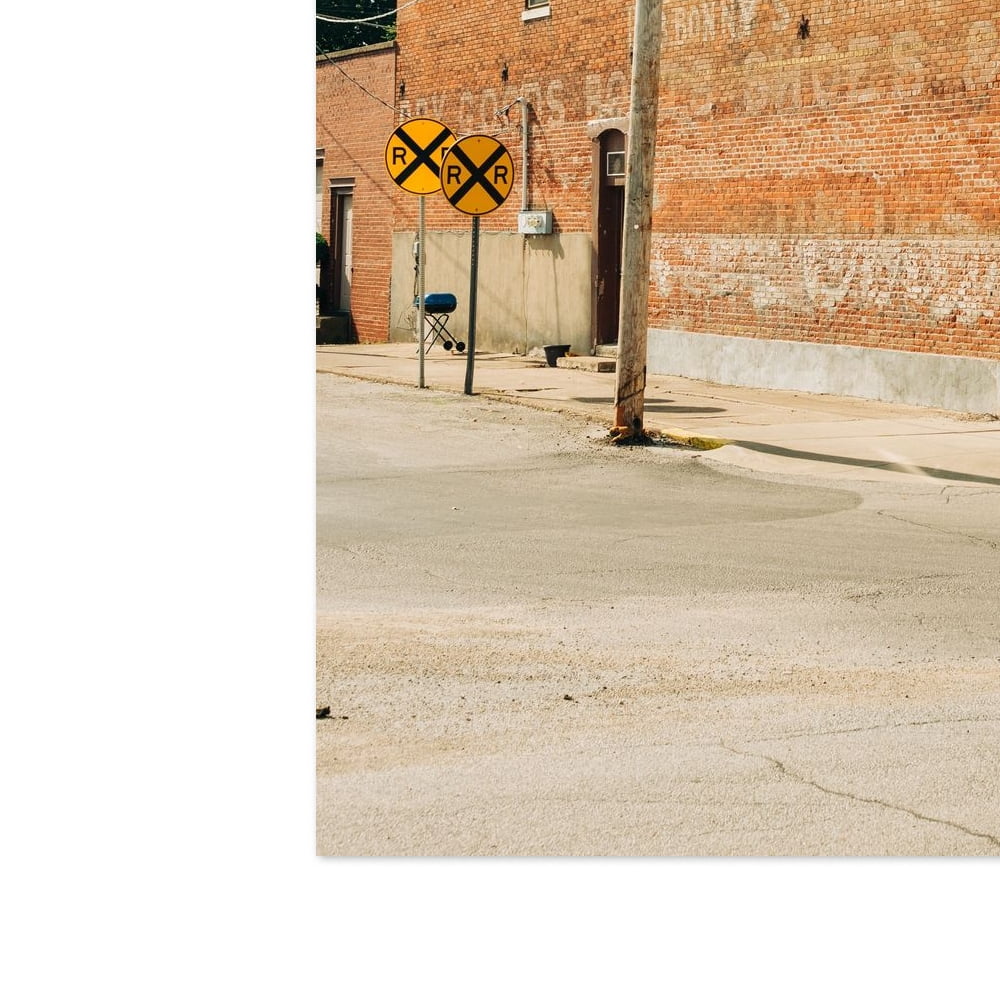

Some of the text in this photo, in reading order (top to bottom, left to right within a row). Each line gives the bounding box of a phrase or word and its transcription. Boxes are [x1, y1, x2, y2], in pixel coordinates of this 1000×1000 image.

[392, 146, 407, 165] R
[447, 165, 508, 184] R R
